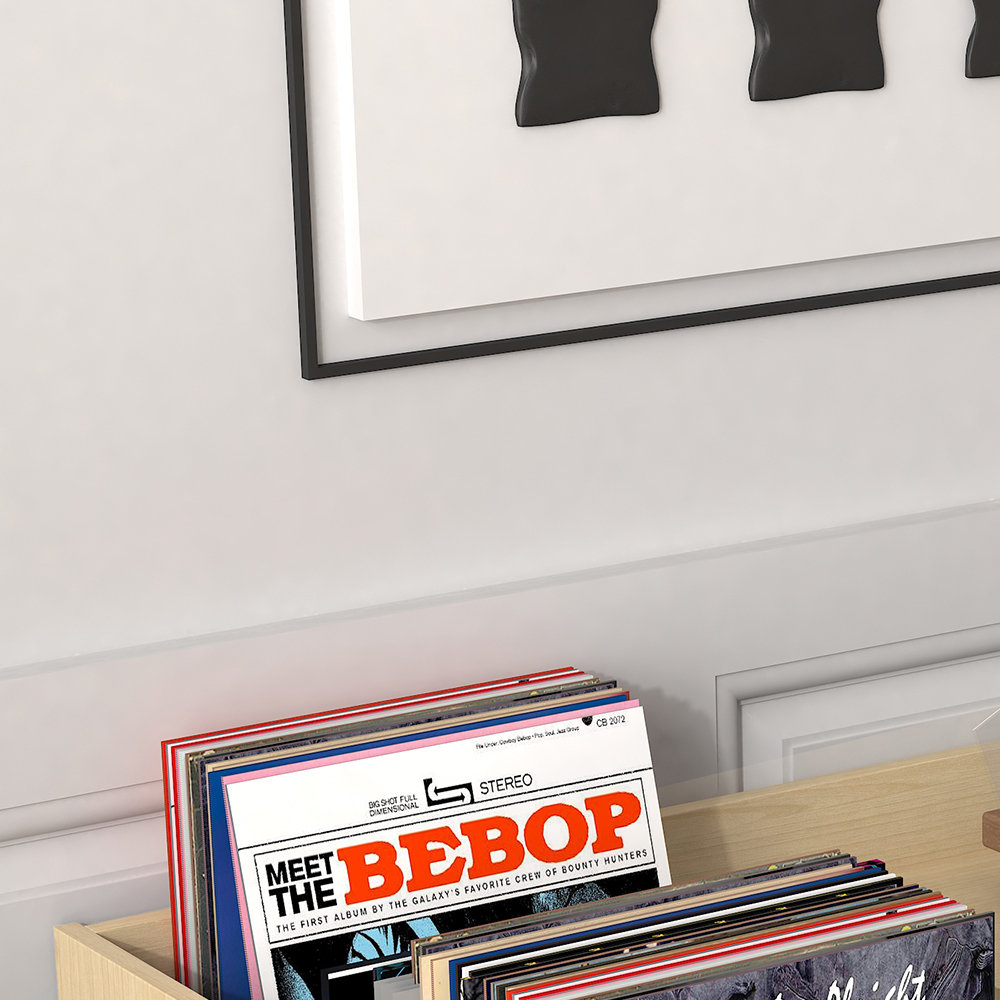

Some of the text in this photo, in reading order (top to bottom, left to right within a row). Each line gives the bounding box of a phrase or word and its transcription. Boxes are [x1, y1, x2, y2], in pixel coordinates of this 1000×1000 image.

[596, 715, 626, 728] CB 2072
[480, 773, 533, 795] STEREO
[369, 793, 418, 809] BIG SHOT FULL
[369, 801, 420, 818] DIMENSIONAL
[337, 791, 642, 905] BEBOP
[265, 851, 334, 887] MEET
[268, 877, 338, 918] THE
[276, 849, 648, 935] THE FIRST ALBUM BY THE GALAXY'S FAVORITE CREW OF BOUNTY HUNTERS
